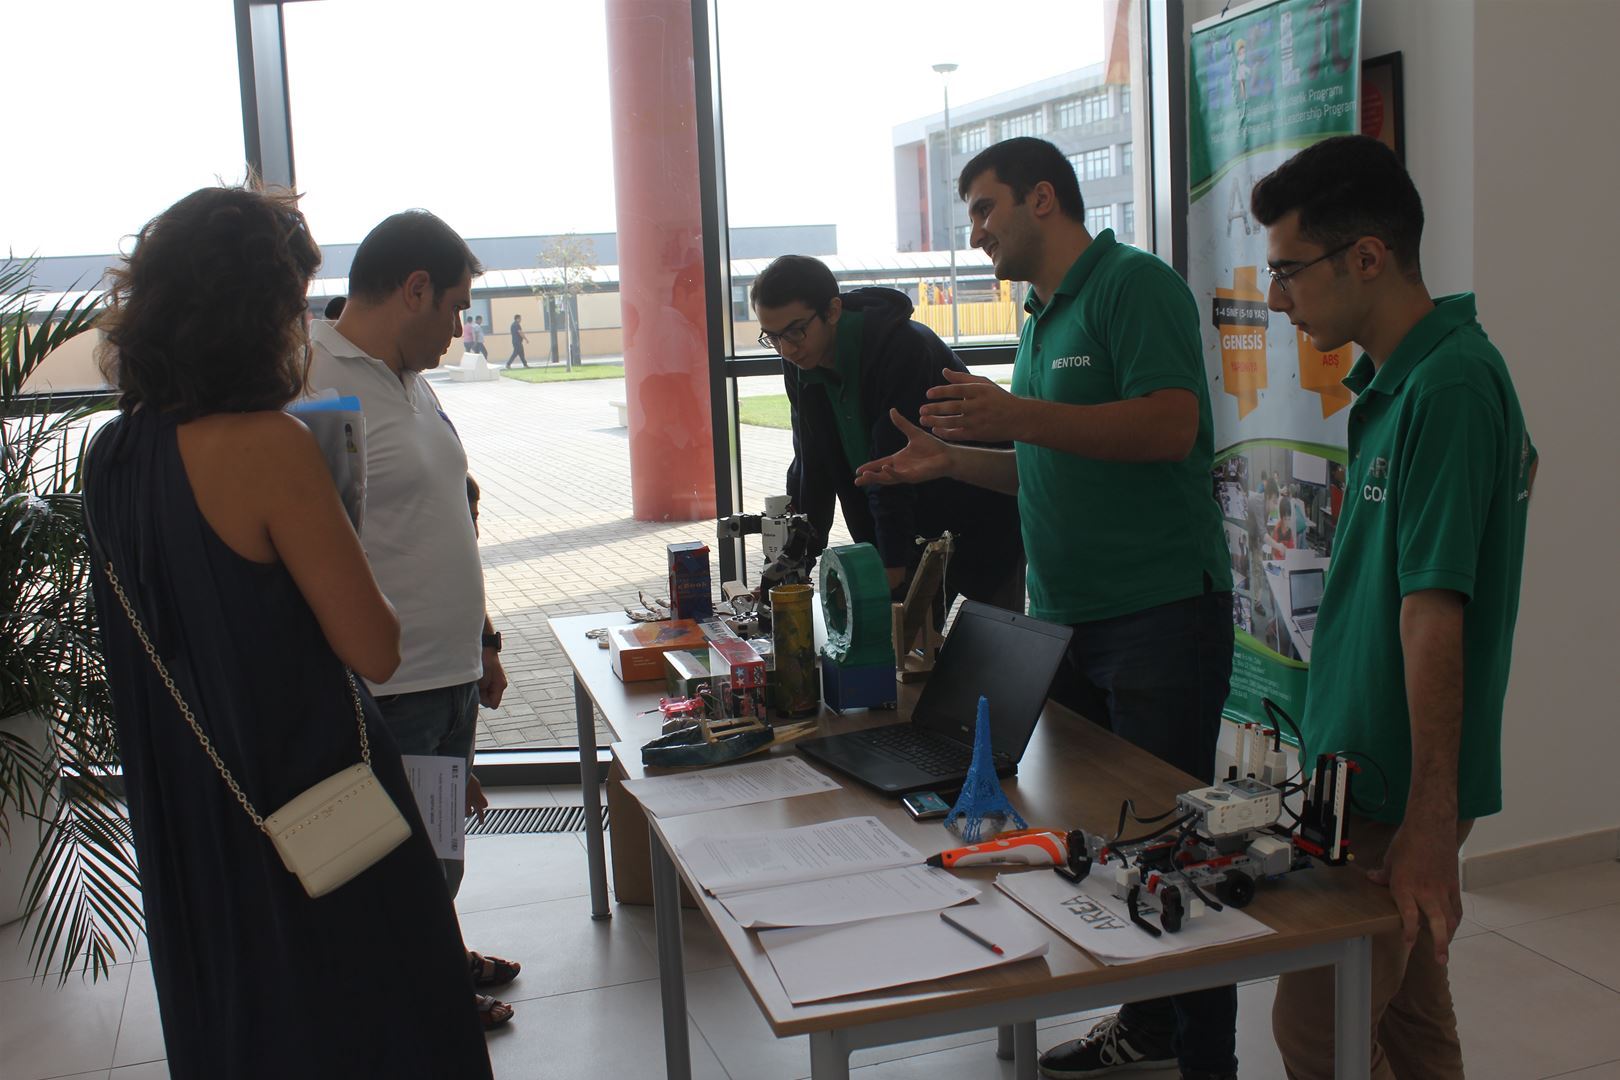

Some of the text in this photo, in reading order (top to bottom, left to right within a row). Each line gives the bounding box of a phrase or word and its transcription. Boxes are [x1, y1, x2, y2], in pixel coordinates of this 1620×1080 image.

[1323, 100, 1357, 118] Program
[1223, 330, 1263, 350] GENESİS
[1051, 355, 1091, 369] MENTOR
[1060, 895, 1125, 930] AREA
